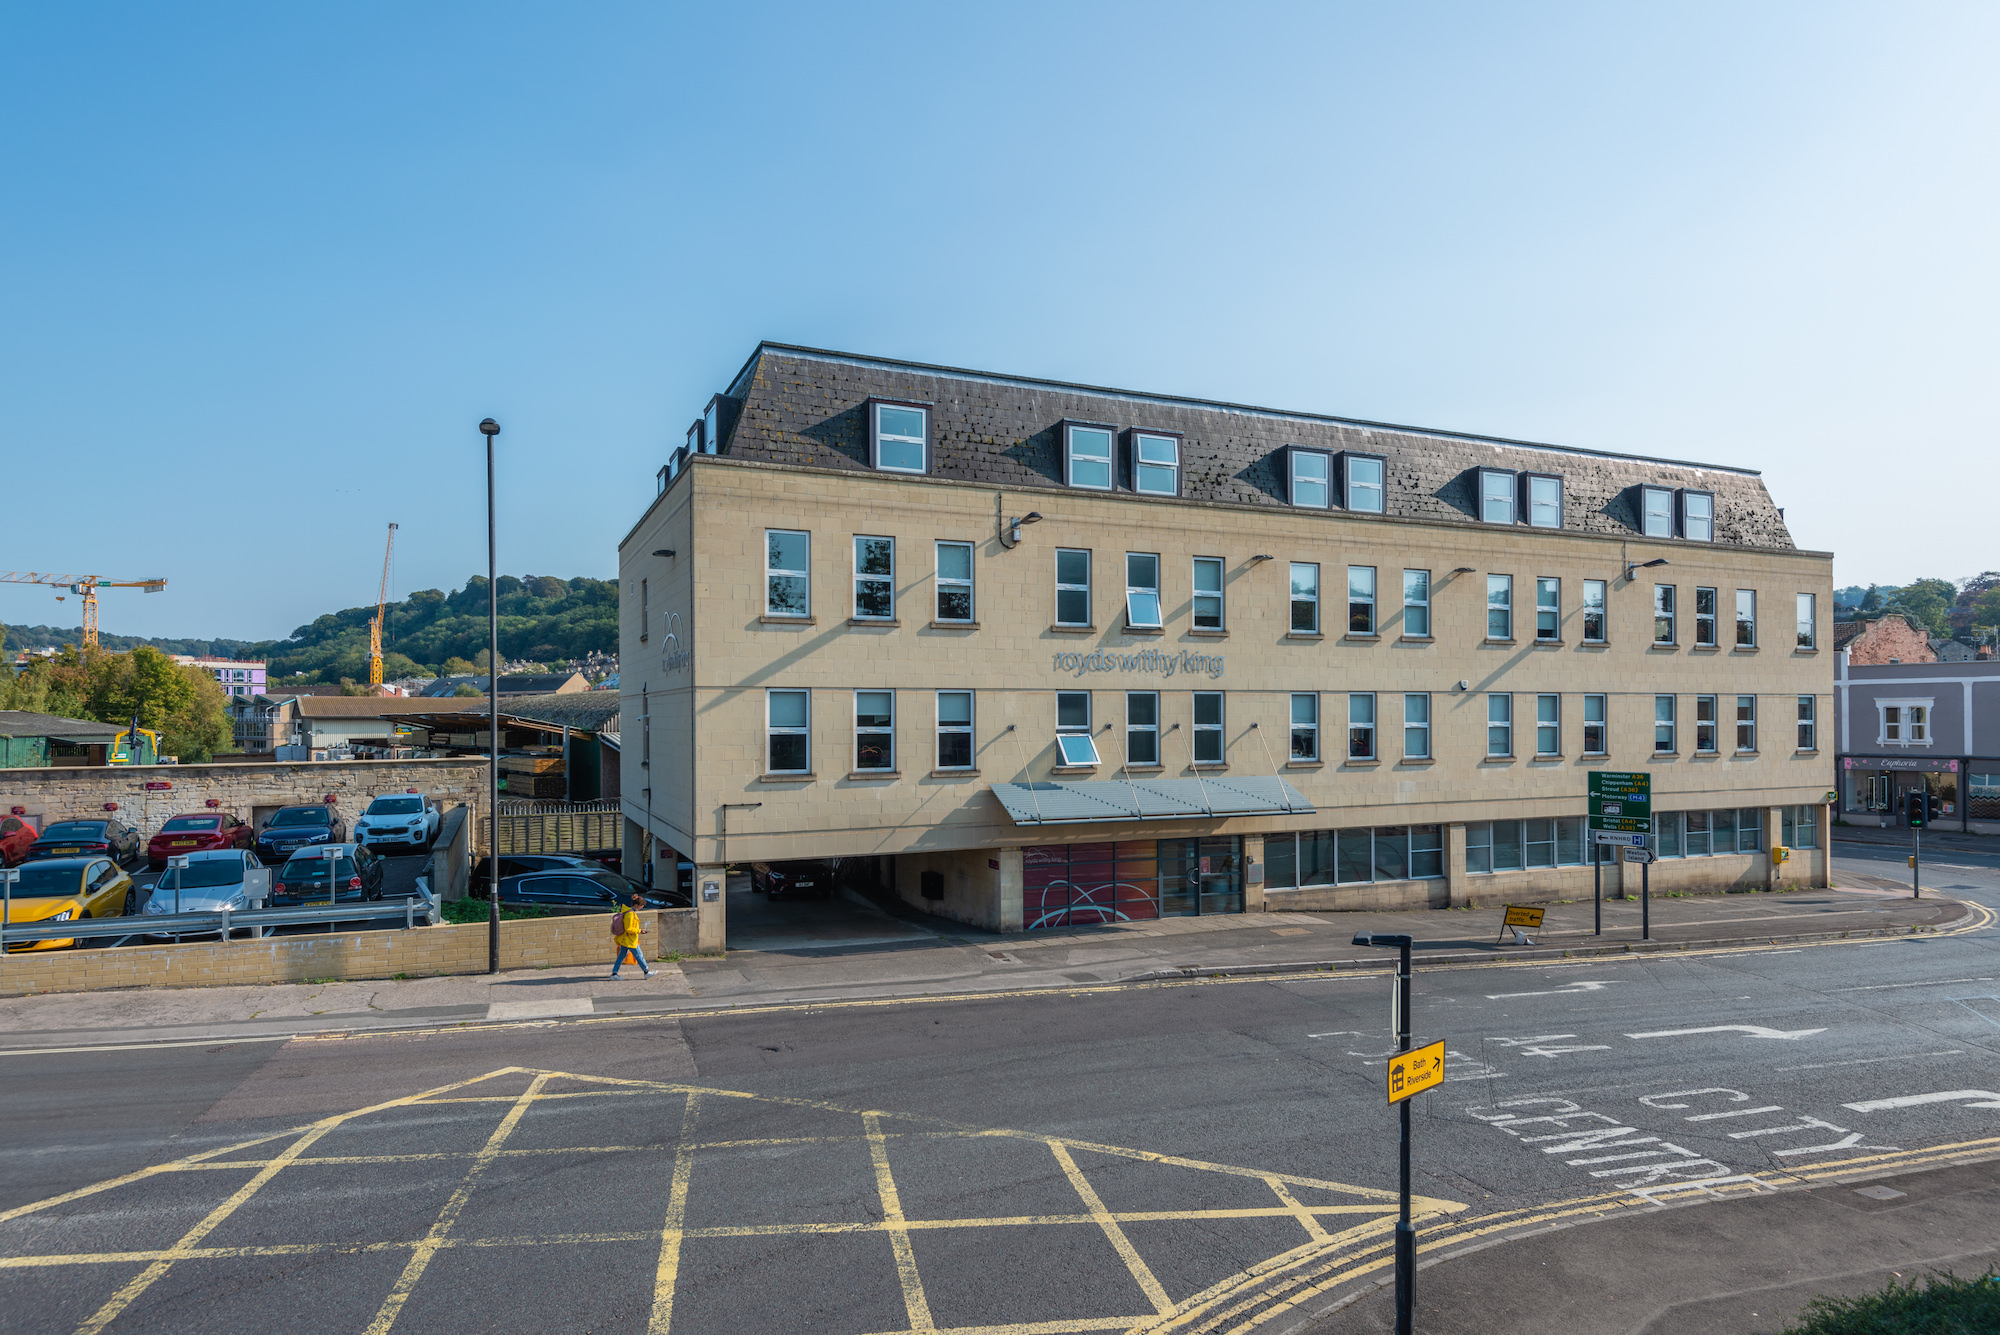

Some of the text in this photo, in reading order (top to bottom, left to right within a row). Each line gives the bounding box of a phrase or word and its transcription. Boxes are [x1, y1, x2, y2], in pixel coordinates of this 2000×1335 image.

[1055, 648, 1226, 677] royds withy king
[1881, 759, 1918, 768] Euphoria
[1413, 1058, 1427, 1070] Bath
[1407, 1069, 1432, 1087] Riverside
[1638, 1088, 1901, 1157] CITY
[1465, 1097, 1780, 1206] CENTRE
